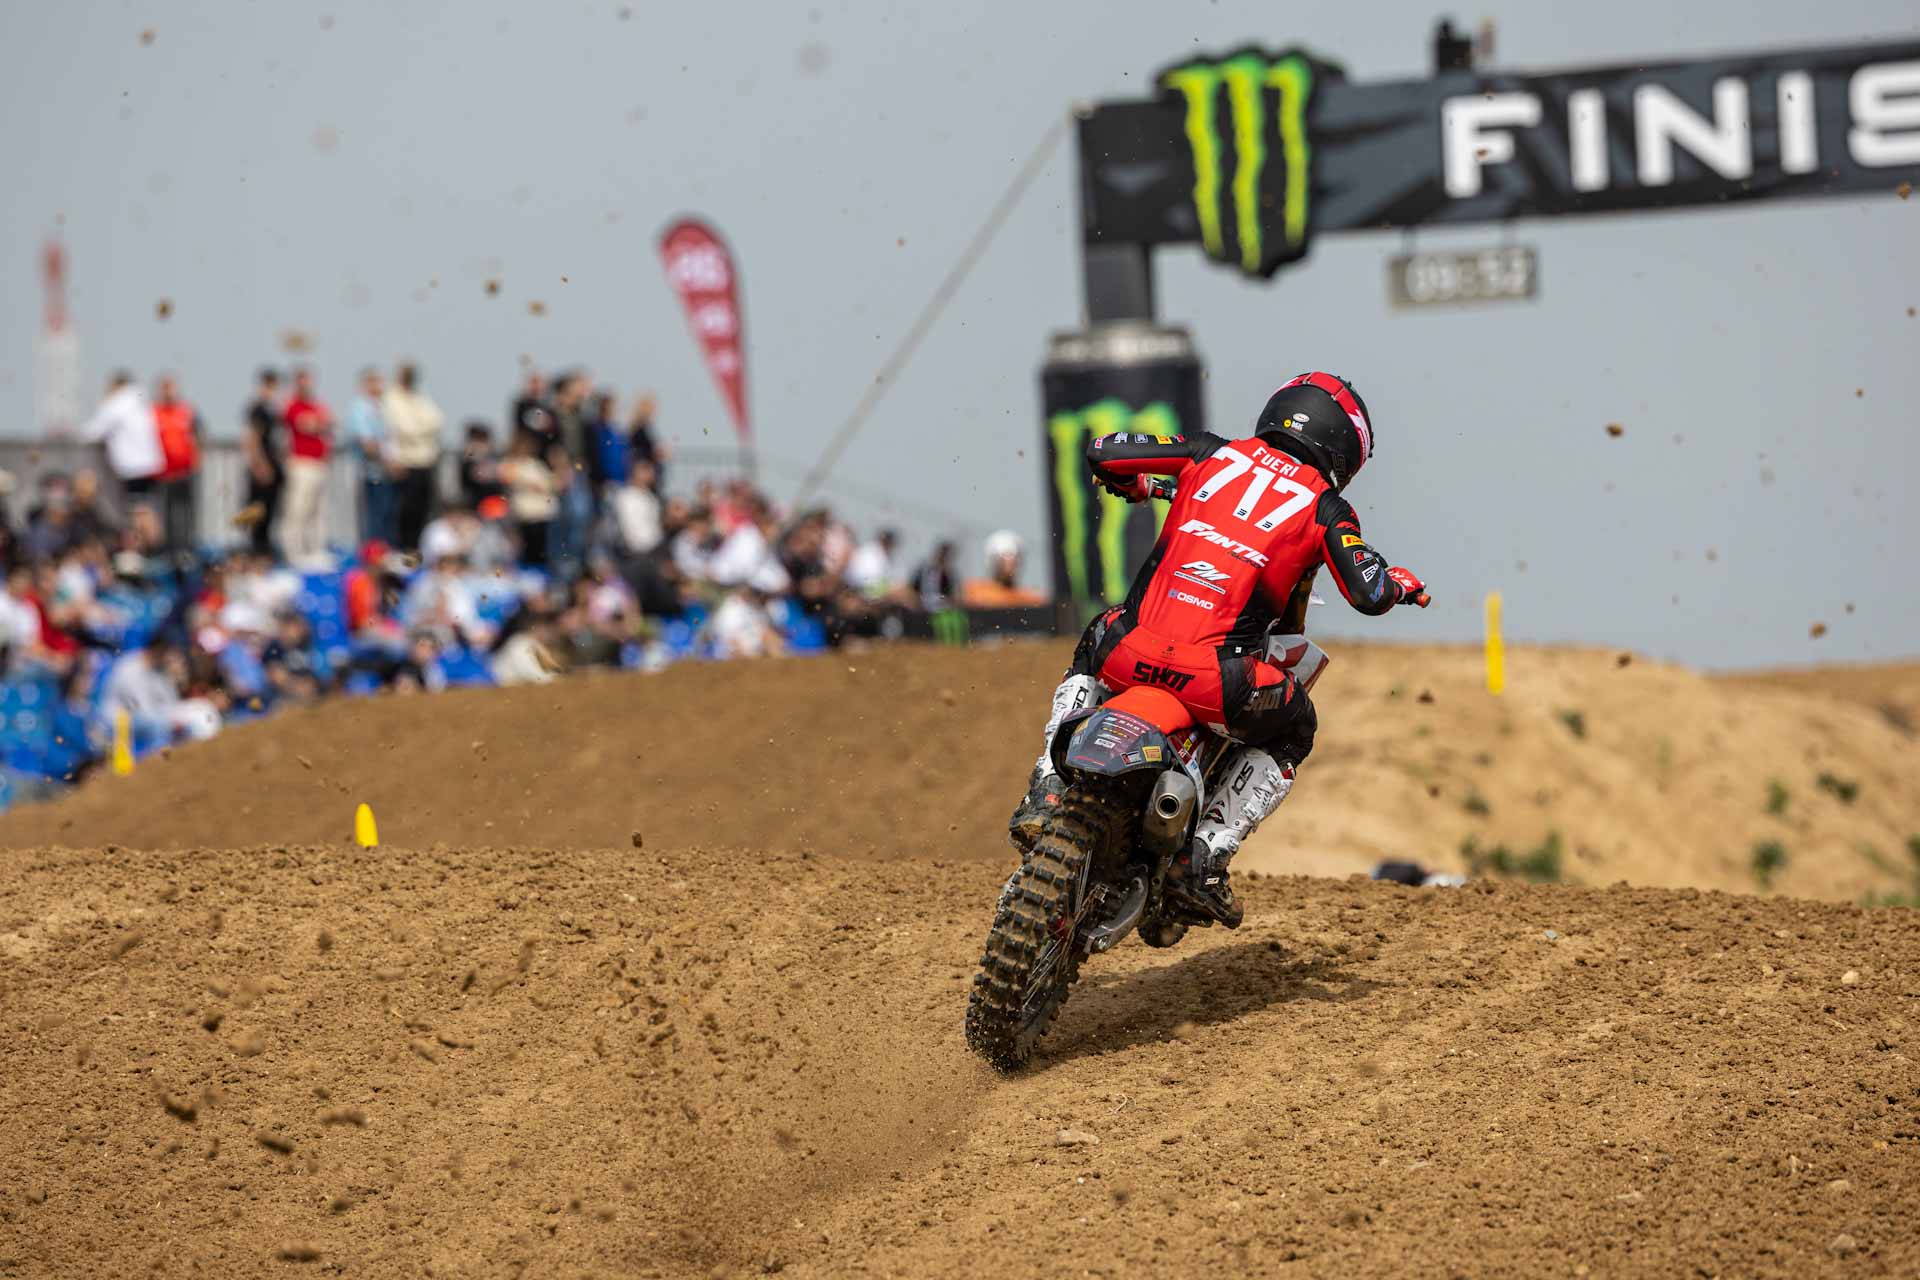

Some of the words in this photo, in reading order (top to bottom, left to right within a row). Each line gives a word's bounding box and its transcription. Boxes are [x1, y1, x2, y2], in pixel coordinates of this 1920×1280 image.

[1252, 446, 1299, 477] FUERI
[1192, 446, 1316, 533] 717
[1178, 519, 1269, 567] FANTIC
[1176, 591, 1215, 610] OSMO
[1132, 660, 1196, 692] SHOT
